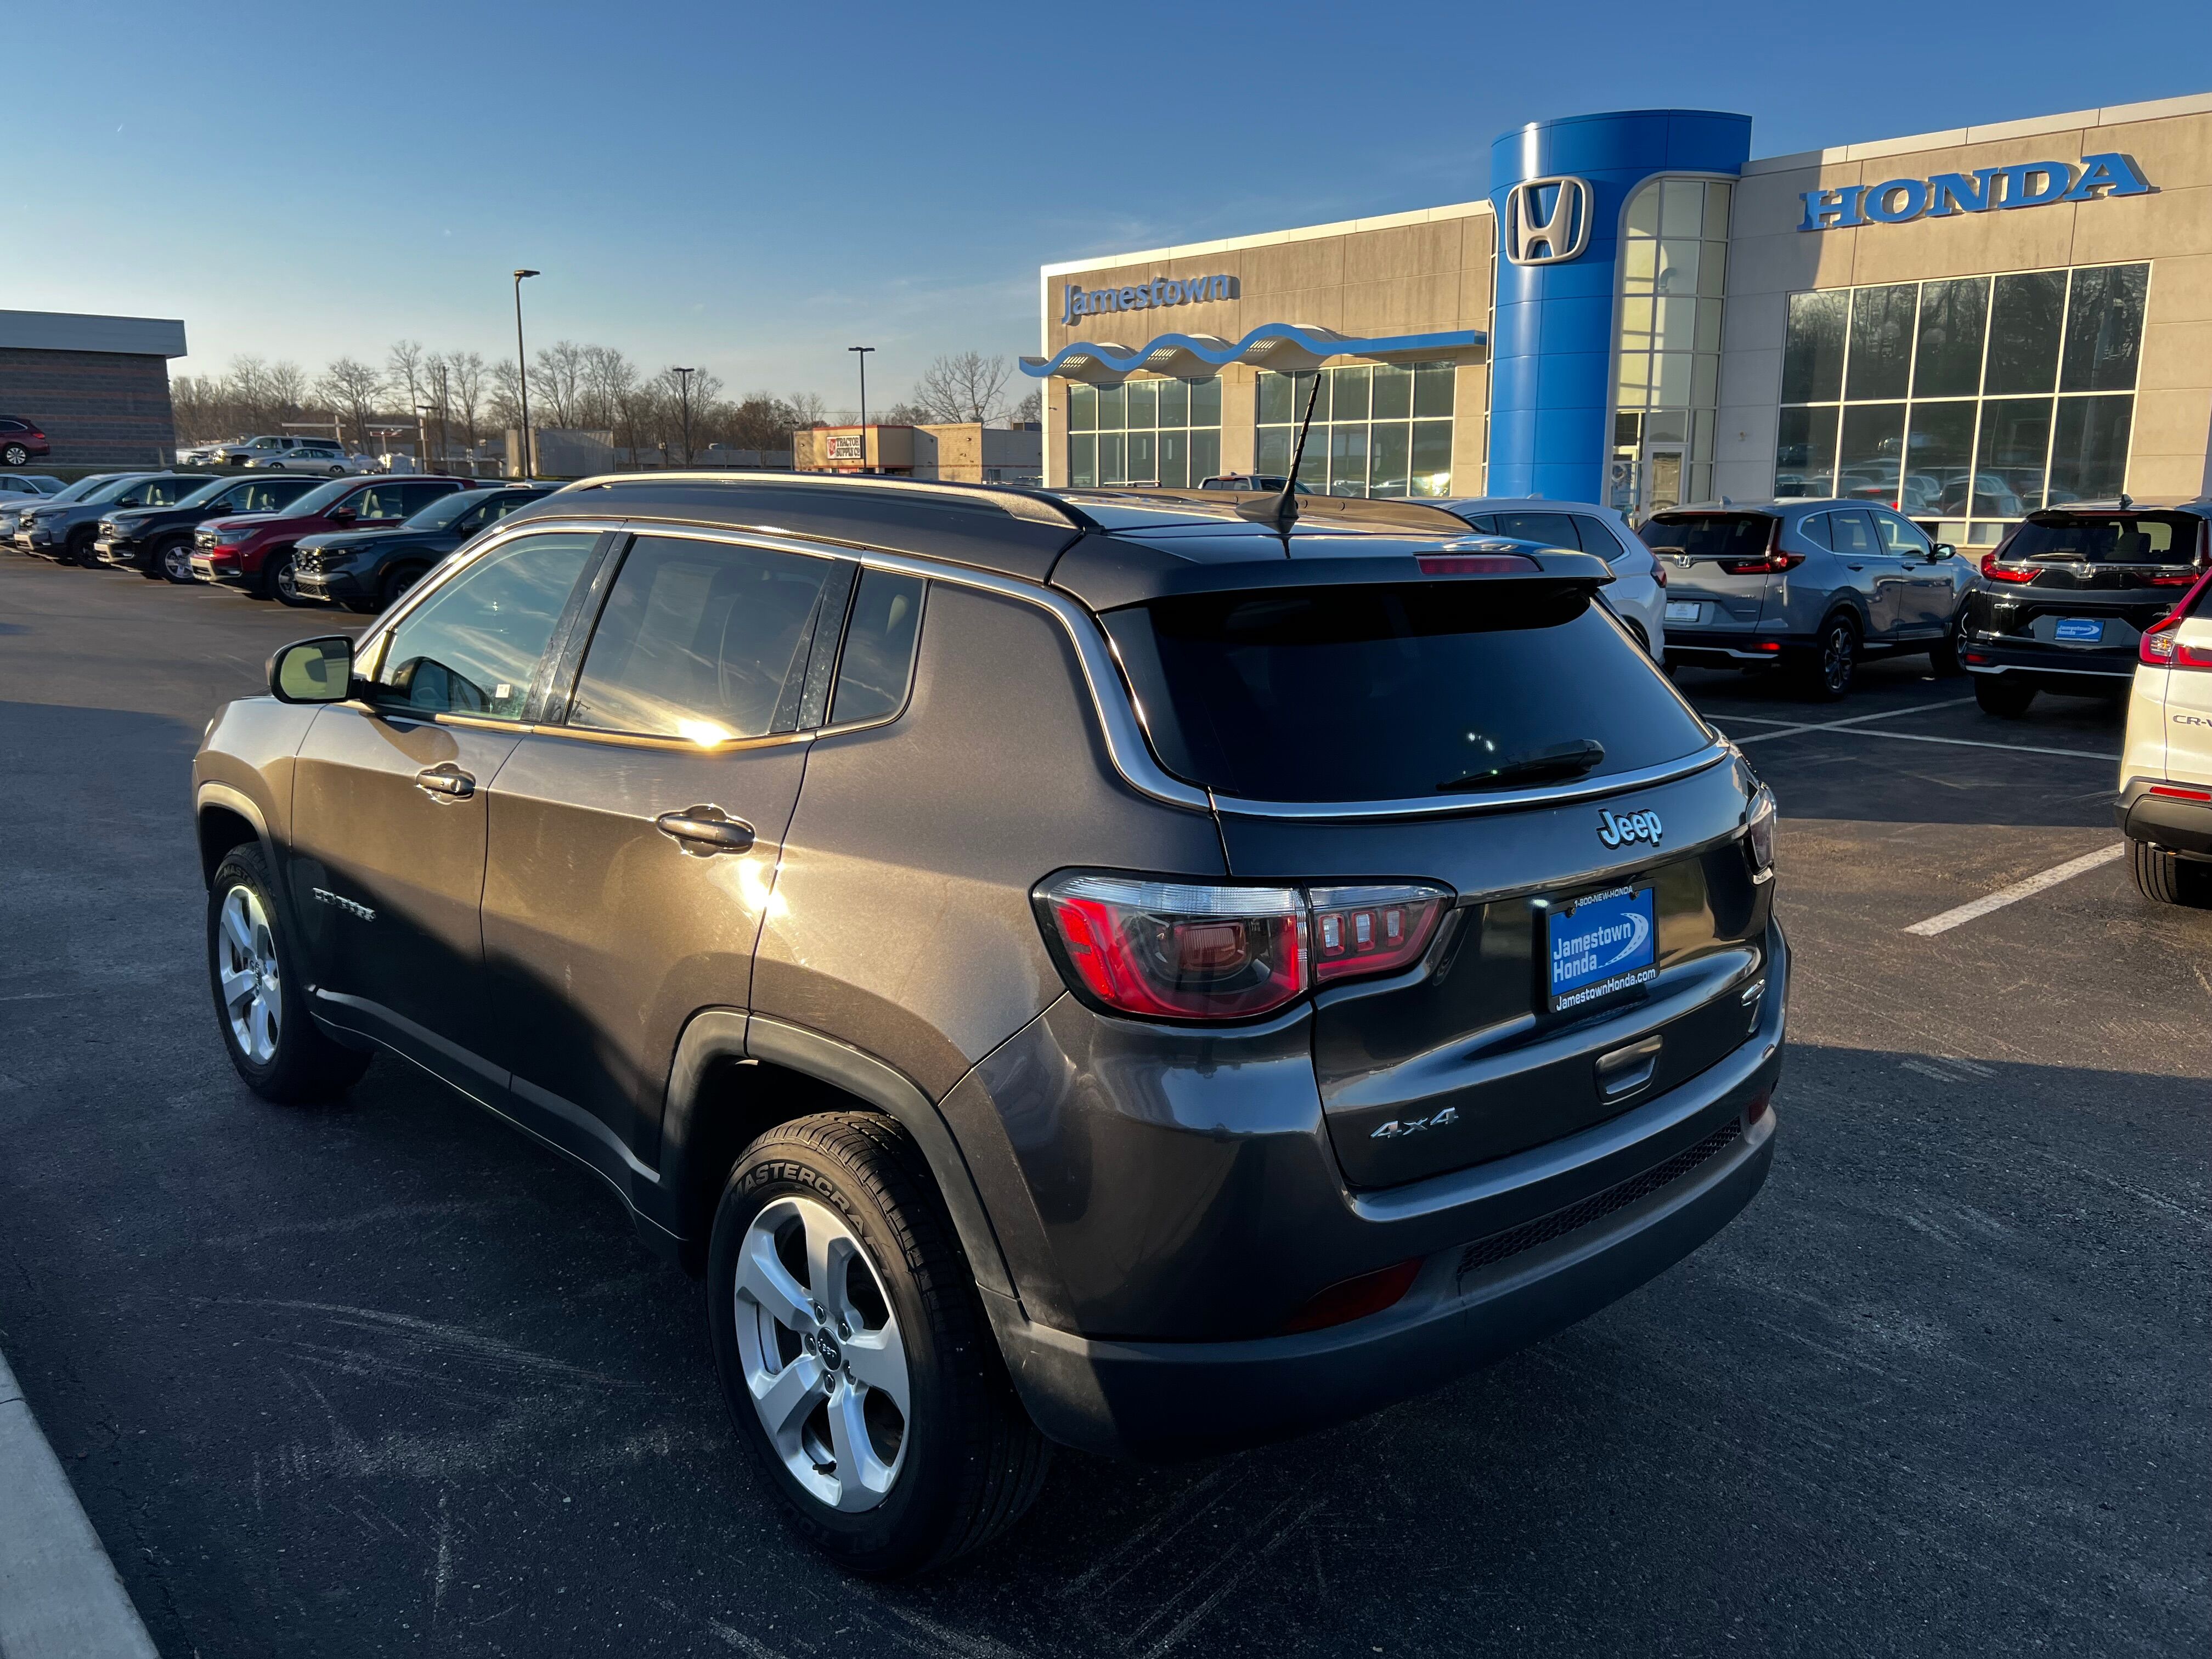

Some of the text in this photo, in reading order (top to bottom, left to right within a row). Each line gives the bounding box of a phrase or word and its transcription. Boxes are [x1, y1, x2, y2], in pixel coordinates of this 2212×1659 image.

[1797, 153, 2149, 232] HONDA
[1062, 274, 1231, 325] Jamestown
[836, 437, 860, 447] TRACTOR
[837, 447, 853, 456] SUPPLY
[1596, 809, 1662, 848] Jeep
[1573, 885, 1633, 908] 1-800-NEW-HONDA
[1553, 922, 1631, 960] Jamestown
[1553, 951, 1598, 983] Honda
[1556, 968, 1656, 1011] JamestownHonda.com
[1369, 1107, 1459, 1139] 4x4
